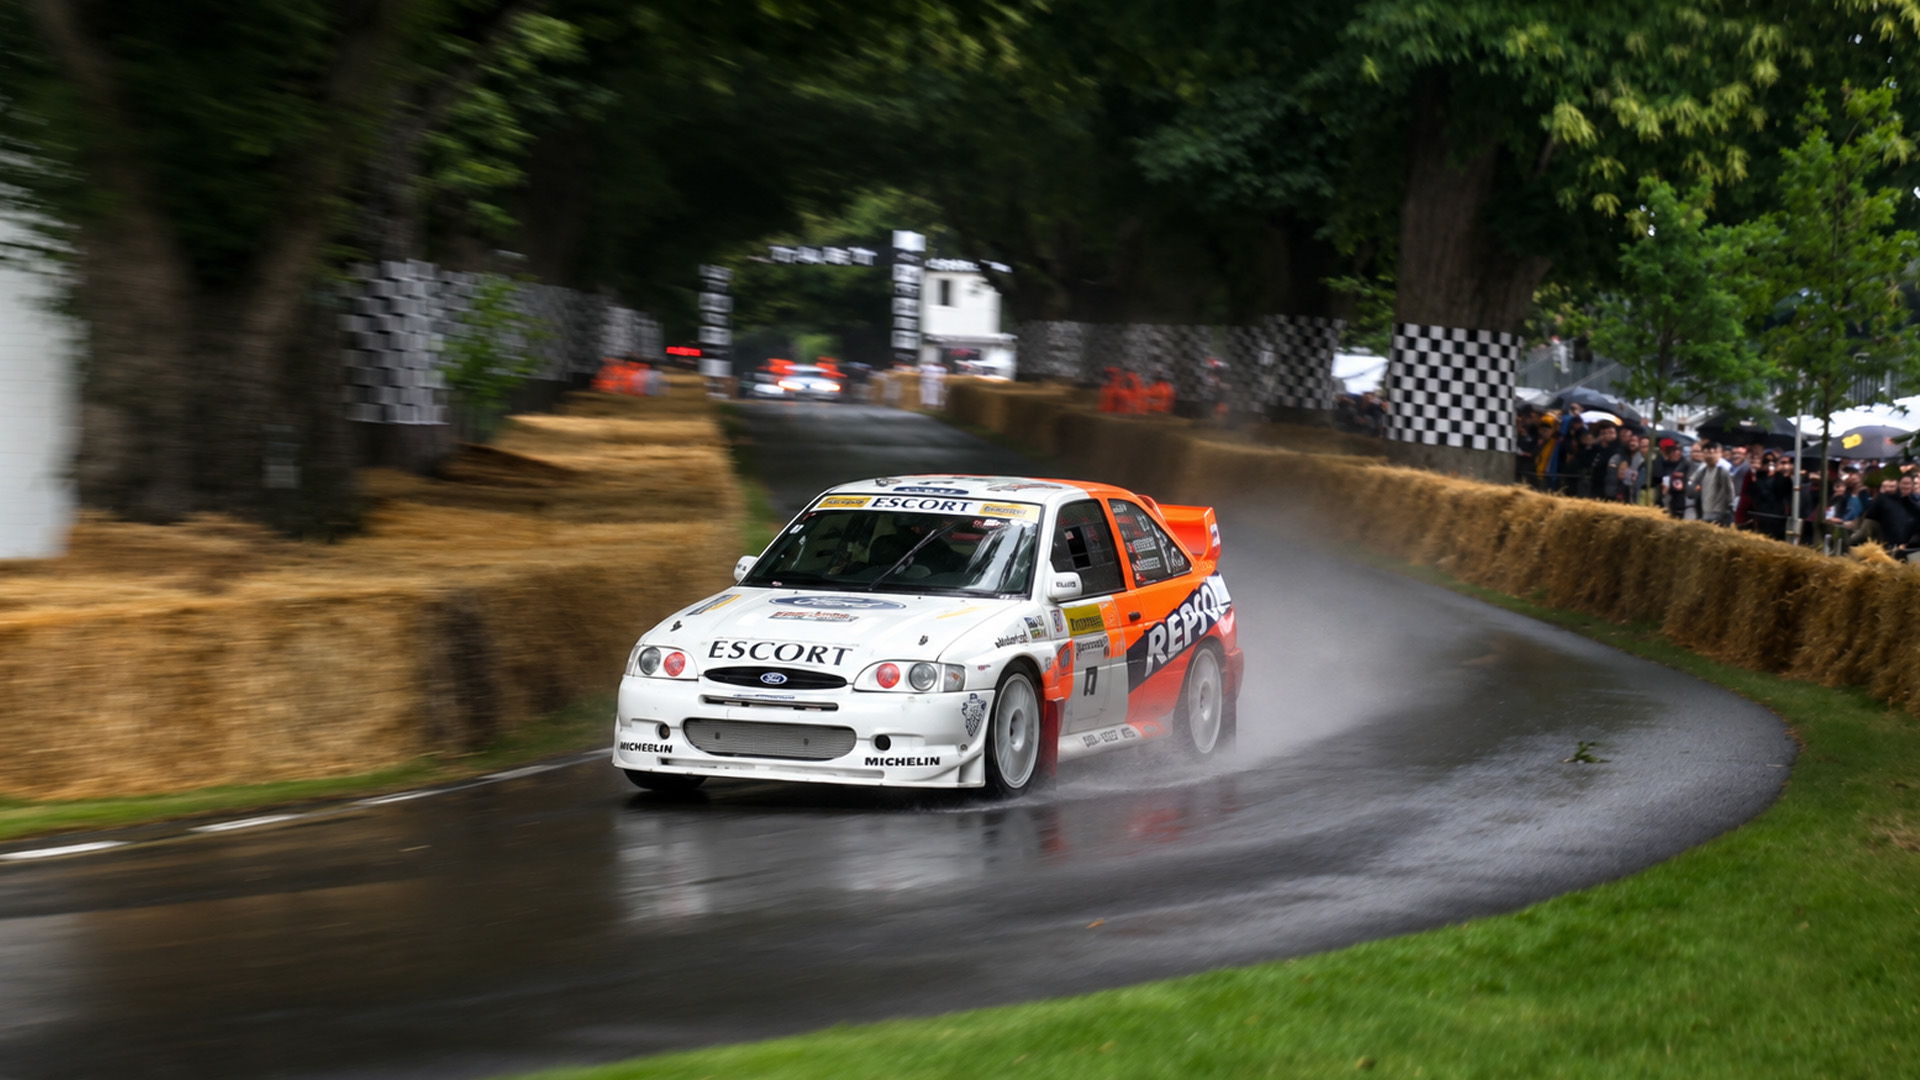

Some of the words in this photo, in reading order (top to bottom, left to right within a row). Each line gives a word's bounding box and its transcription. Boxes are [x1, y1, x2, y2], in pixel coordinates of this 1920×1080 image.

[871, 497, 973, 513] ESCORT
[708, 640, 853, 666] ESCORT
[865, 756, 941, 767] MICHELIN
